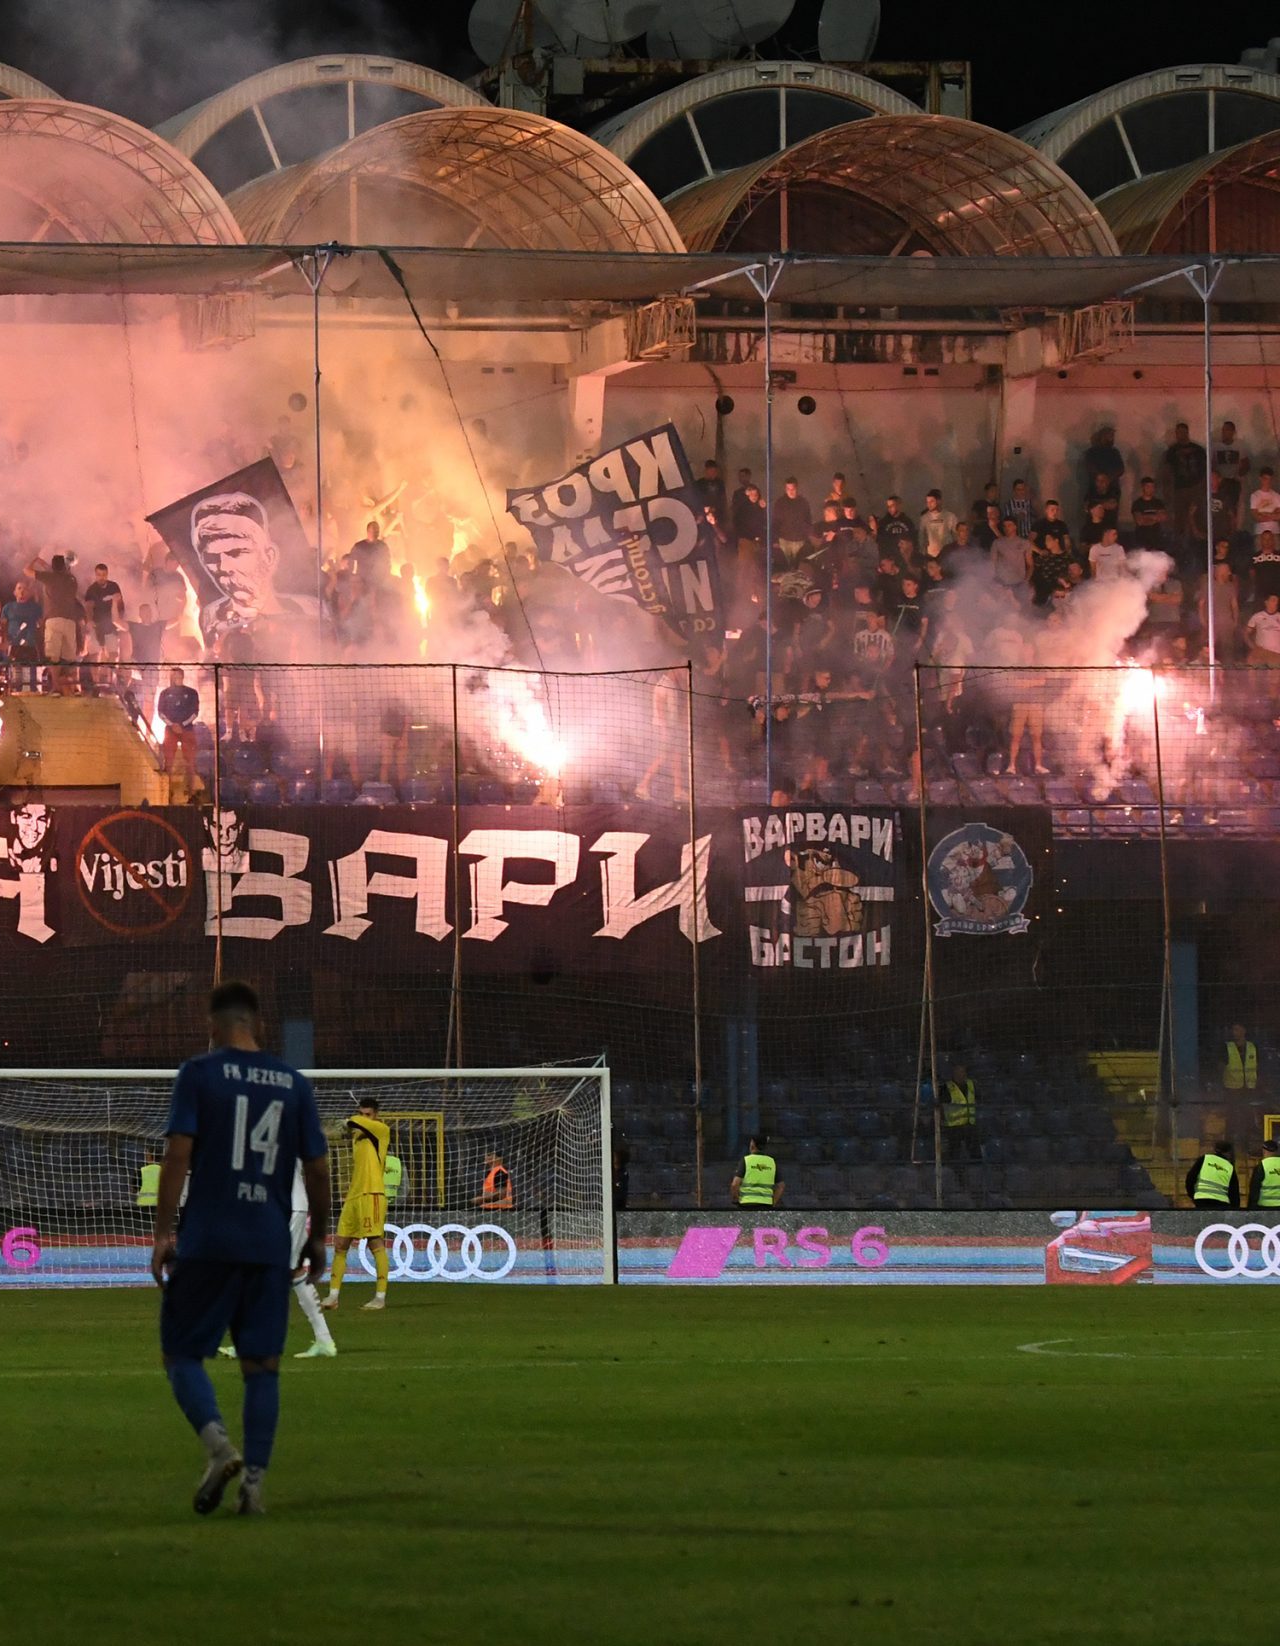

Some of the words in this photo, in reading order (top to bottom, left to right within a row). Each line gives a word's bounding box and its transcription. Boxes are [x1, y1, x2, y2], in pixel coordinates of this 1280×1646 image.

[742, 812, 894, 864] ВАРВАРИ
[79, 849, 188, 901] Vijesti
[749, 924, 891, 969] БАСТОН
[223, 1063, 242, 1081] FK
[232, 1094, 284, 1176] 14
[1, 1227, 42, 1269] 6
[753, 1226, 832, 1268] RS
[852, 1226, 889, 1268] 6
